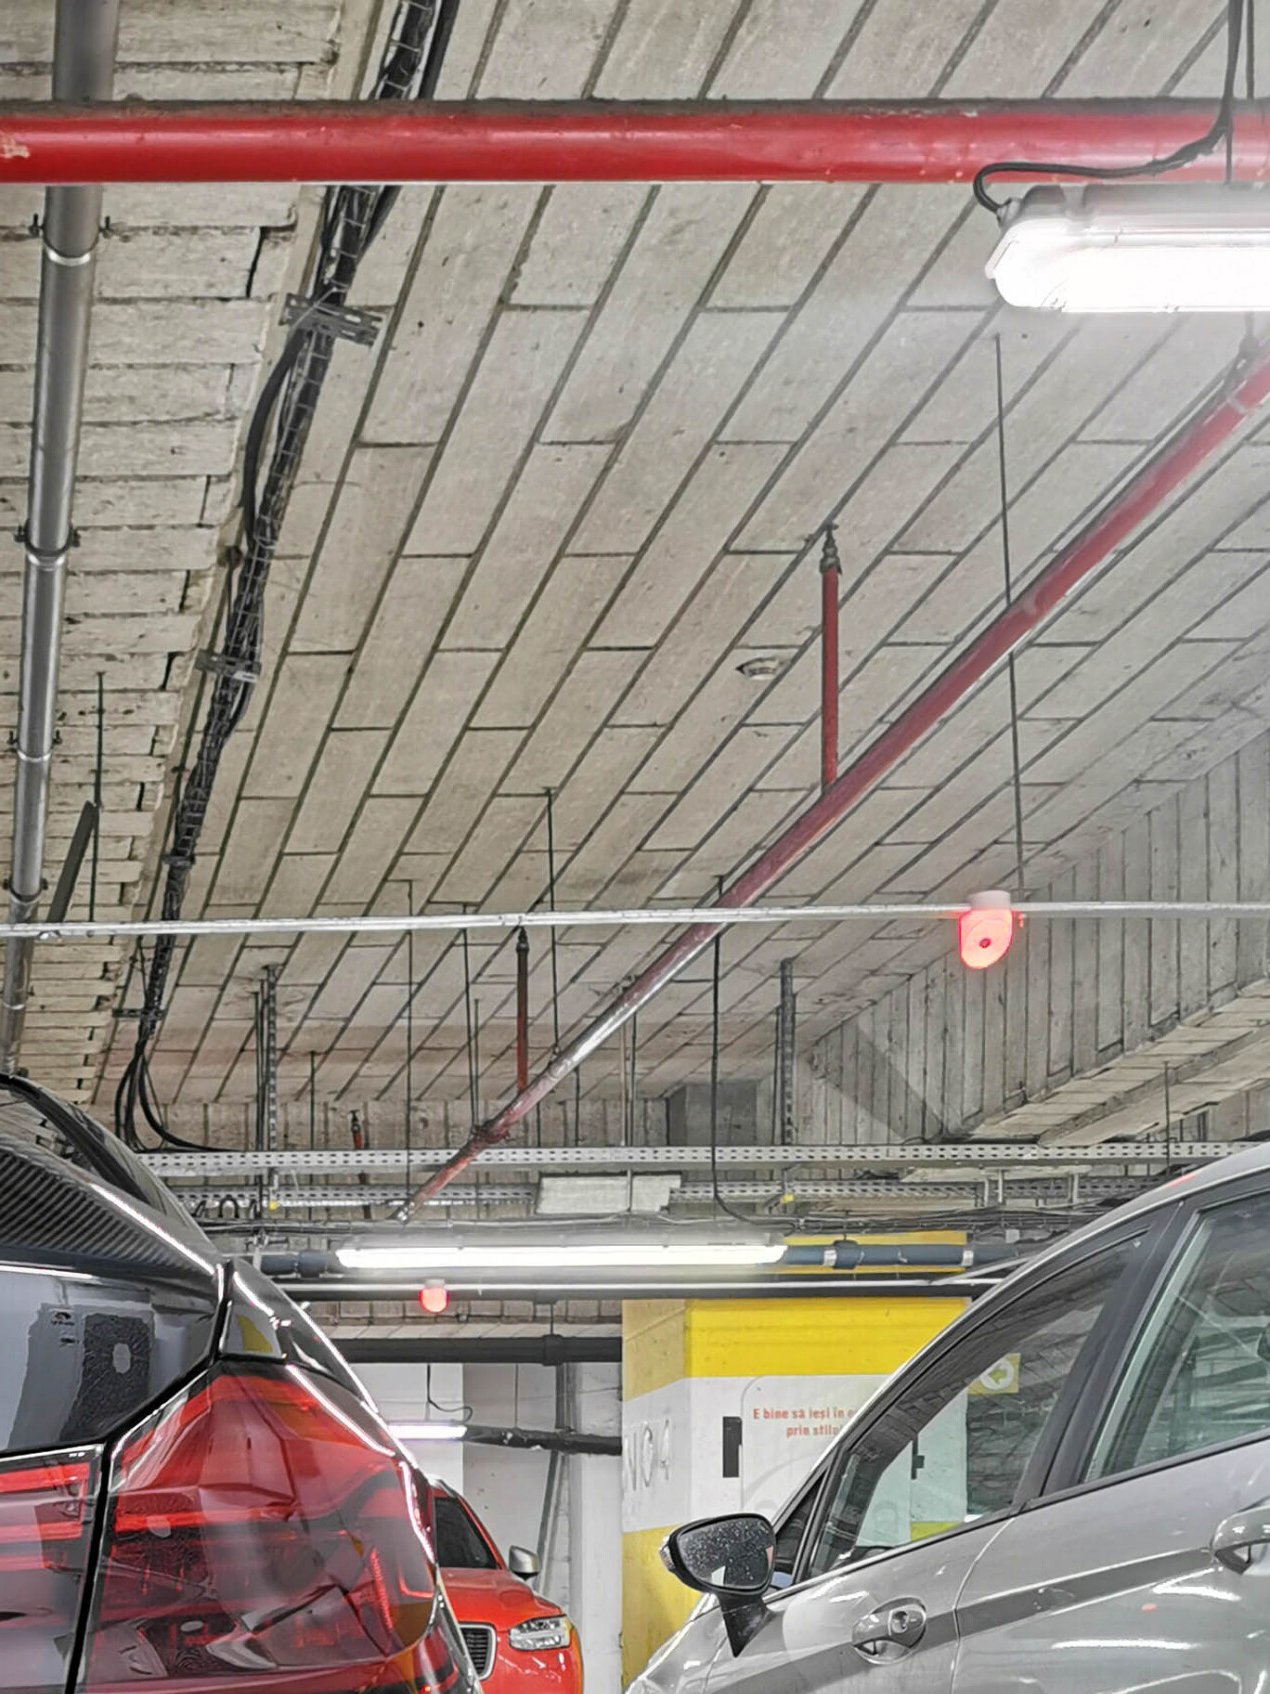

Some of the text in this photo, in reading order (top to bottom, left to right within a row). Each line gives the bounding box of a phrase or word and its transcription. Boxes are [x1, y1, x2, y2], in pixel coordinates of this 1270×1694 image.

[753, 1408, 760, 1419] E
[763, 1407, 789, 1419] bine
[786, 1424, 810, 1439] prin
